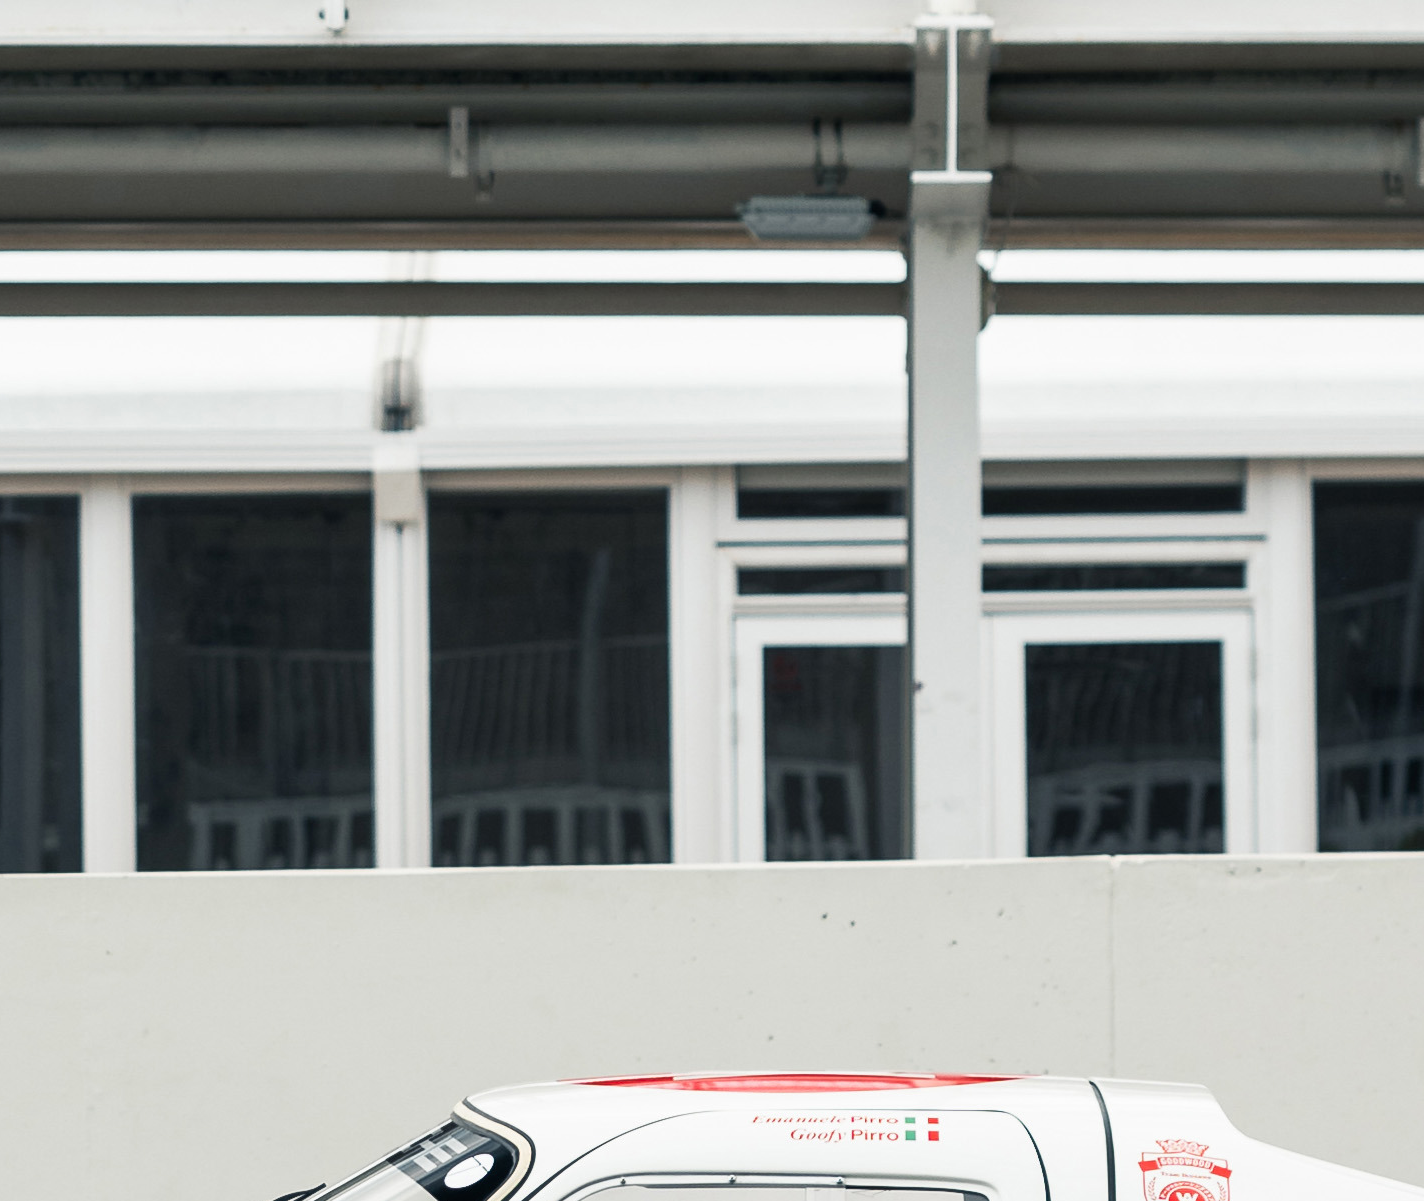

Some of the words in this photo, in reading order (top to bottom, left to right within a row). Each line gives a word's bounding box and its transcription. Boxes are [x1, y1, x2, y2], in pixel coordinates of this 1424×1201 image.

[752, 1114, 847, 1125] Emanuele
[851, 1115, 899, 1125] Pirro
[790, 1127, 847, 1144] Goofy
[851, 1128, 900, 1142] Pirro
[1160, 1157, 1212, 1169] GOODWOOD
